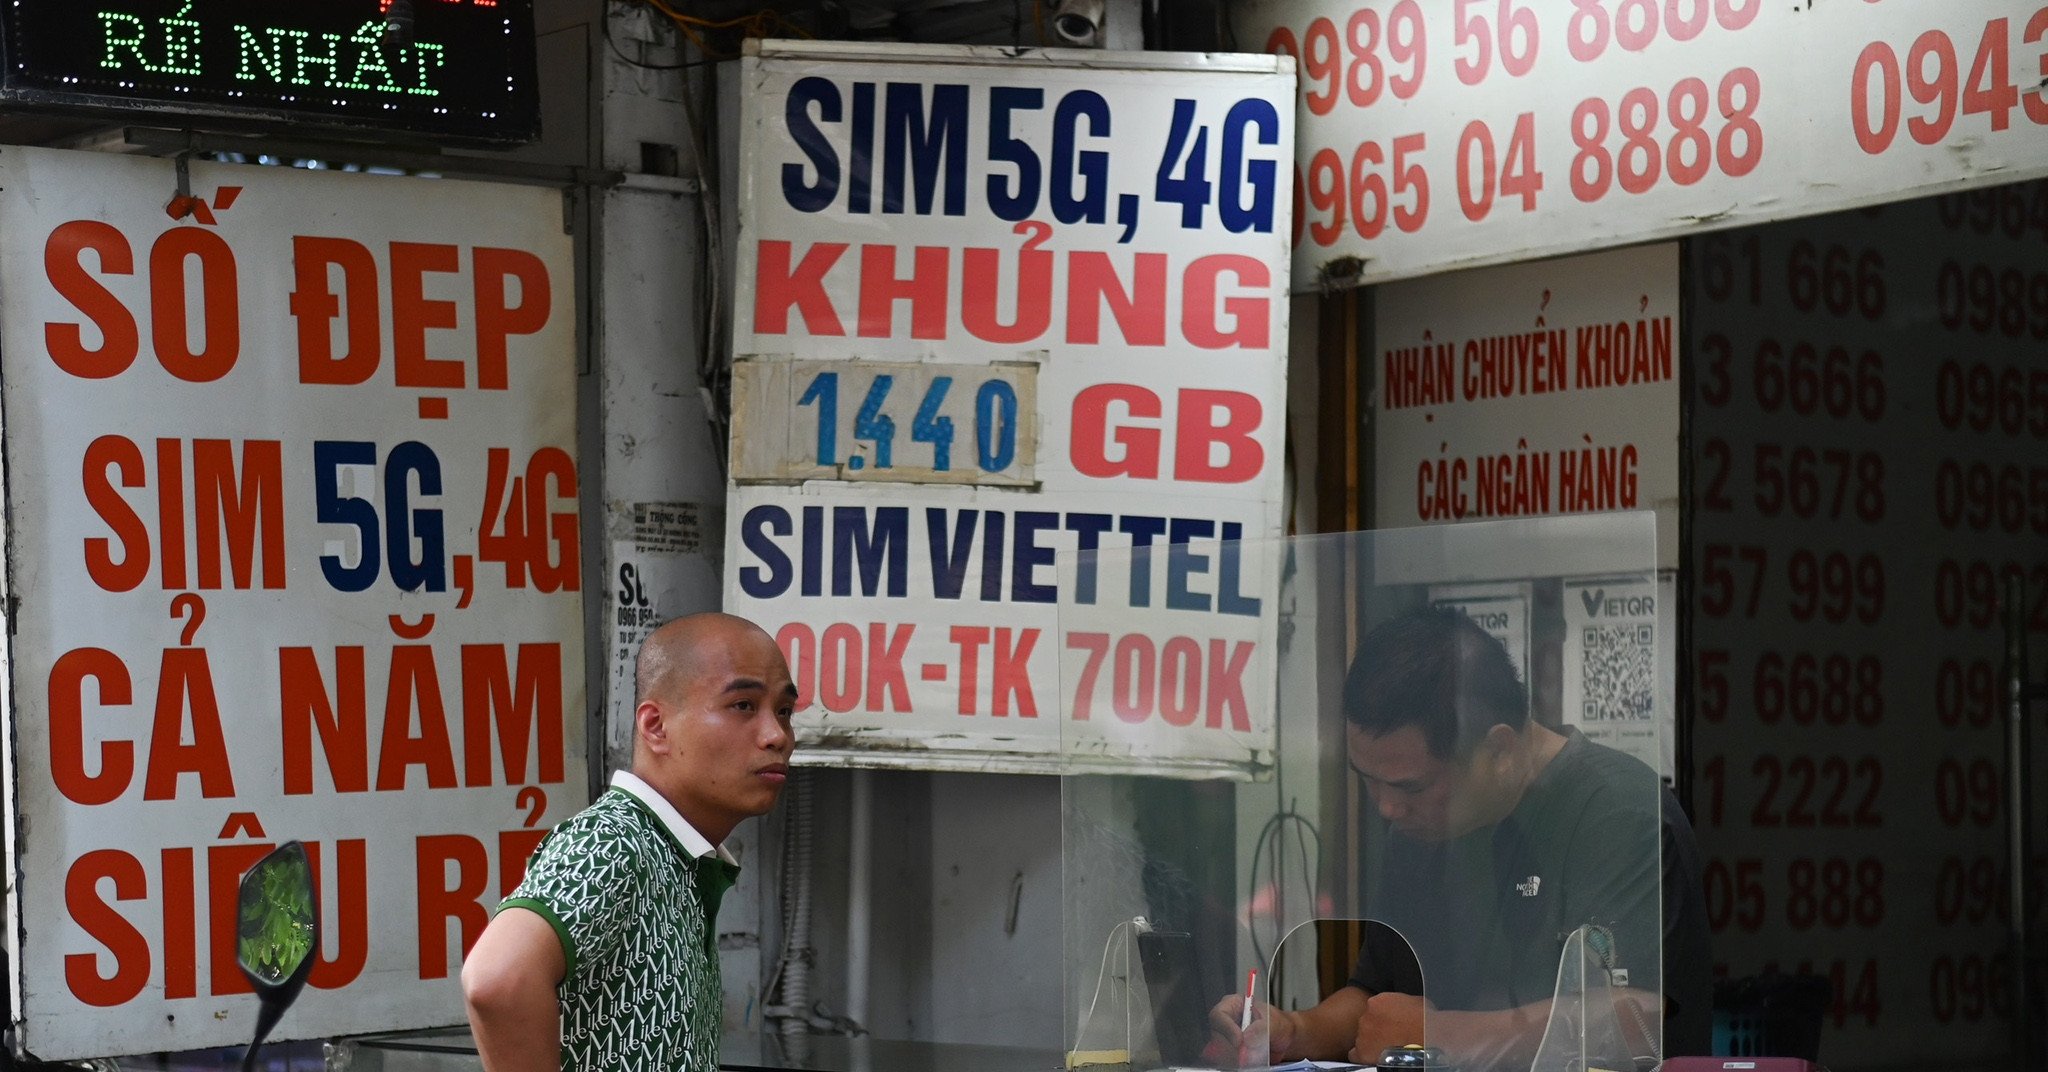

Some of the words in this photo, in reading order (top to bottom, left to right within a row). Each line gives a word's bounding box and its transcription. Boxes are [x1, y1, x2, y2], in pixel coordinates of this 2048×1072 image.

[1454, 0, 1539, 86] 56
[781, 76, 969, 216] SIM
[1293, 133, 1430, 247] 965
[1457, 112, 1543, 221] 04
[1570, 67, 1763, 203] 8888
[44, 186, 243, 383] SỐ
[289, 234, 551, 419] ĐẸP
[753, 220, 1271, 349] KHỦNG
[1788, 239, 1885, 321] 666
[1385, 329, 1455, 423] NHẬN
[1463, 288, 1567, 402] CHUYỂN
[1576, 294, 1672, 389] KHOẢN
[1754, 338, 1886, 422] 6666
[797, 372, 1018, 473] 1.440
[1069, 383, 1265, 483] GB
[1418, 441, 1467, 521] CÁC
[1477, 437, 1551, 517] NGÂN
[1559, 433, 1638, 513] HÀNG
[82, 434, 286, 593] SIM
[1755, 443, 1886, 523] 5678
[739, 505, 909, 599] SIM
[926, 507, 1262, 617] VIETTEL
[1581, 588, 1655, 618] VIETQR
[1702, 545, 1767, 619] 57
[1788, 549, 1885, 625] 999
[48, 593, 236, 805] CẢ
[279, 613, 565, 795] NĂM
[776, 622, 1041, 718] 00K-TK
[1066, 632, 1254, 732] 700K
[1754, 651, 1885, 727] 6688
[1752, 755, 1884, 828] 2222
[1786, 857, 1884, 929] 888
